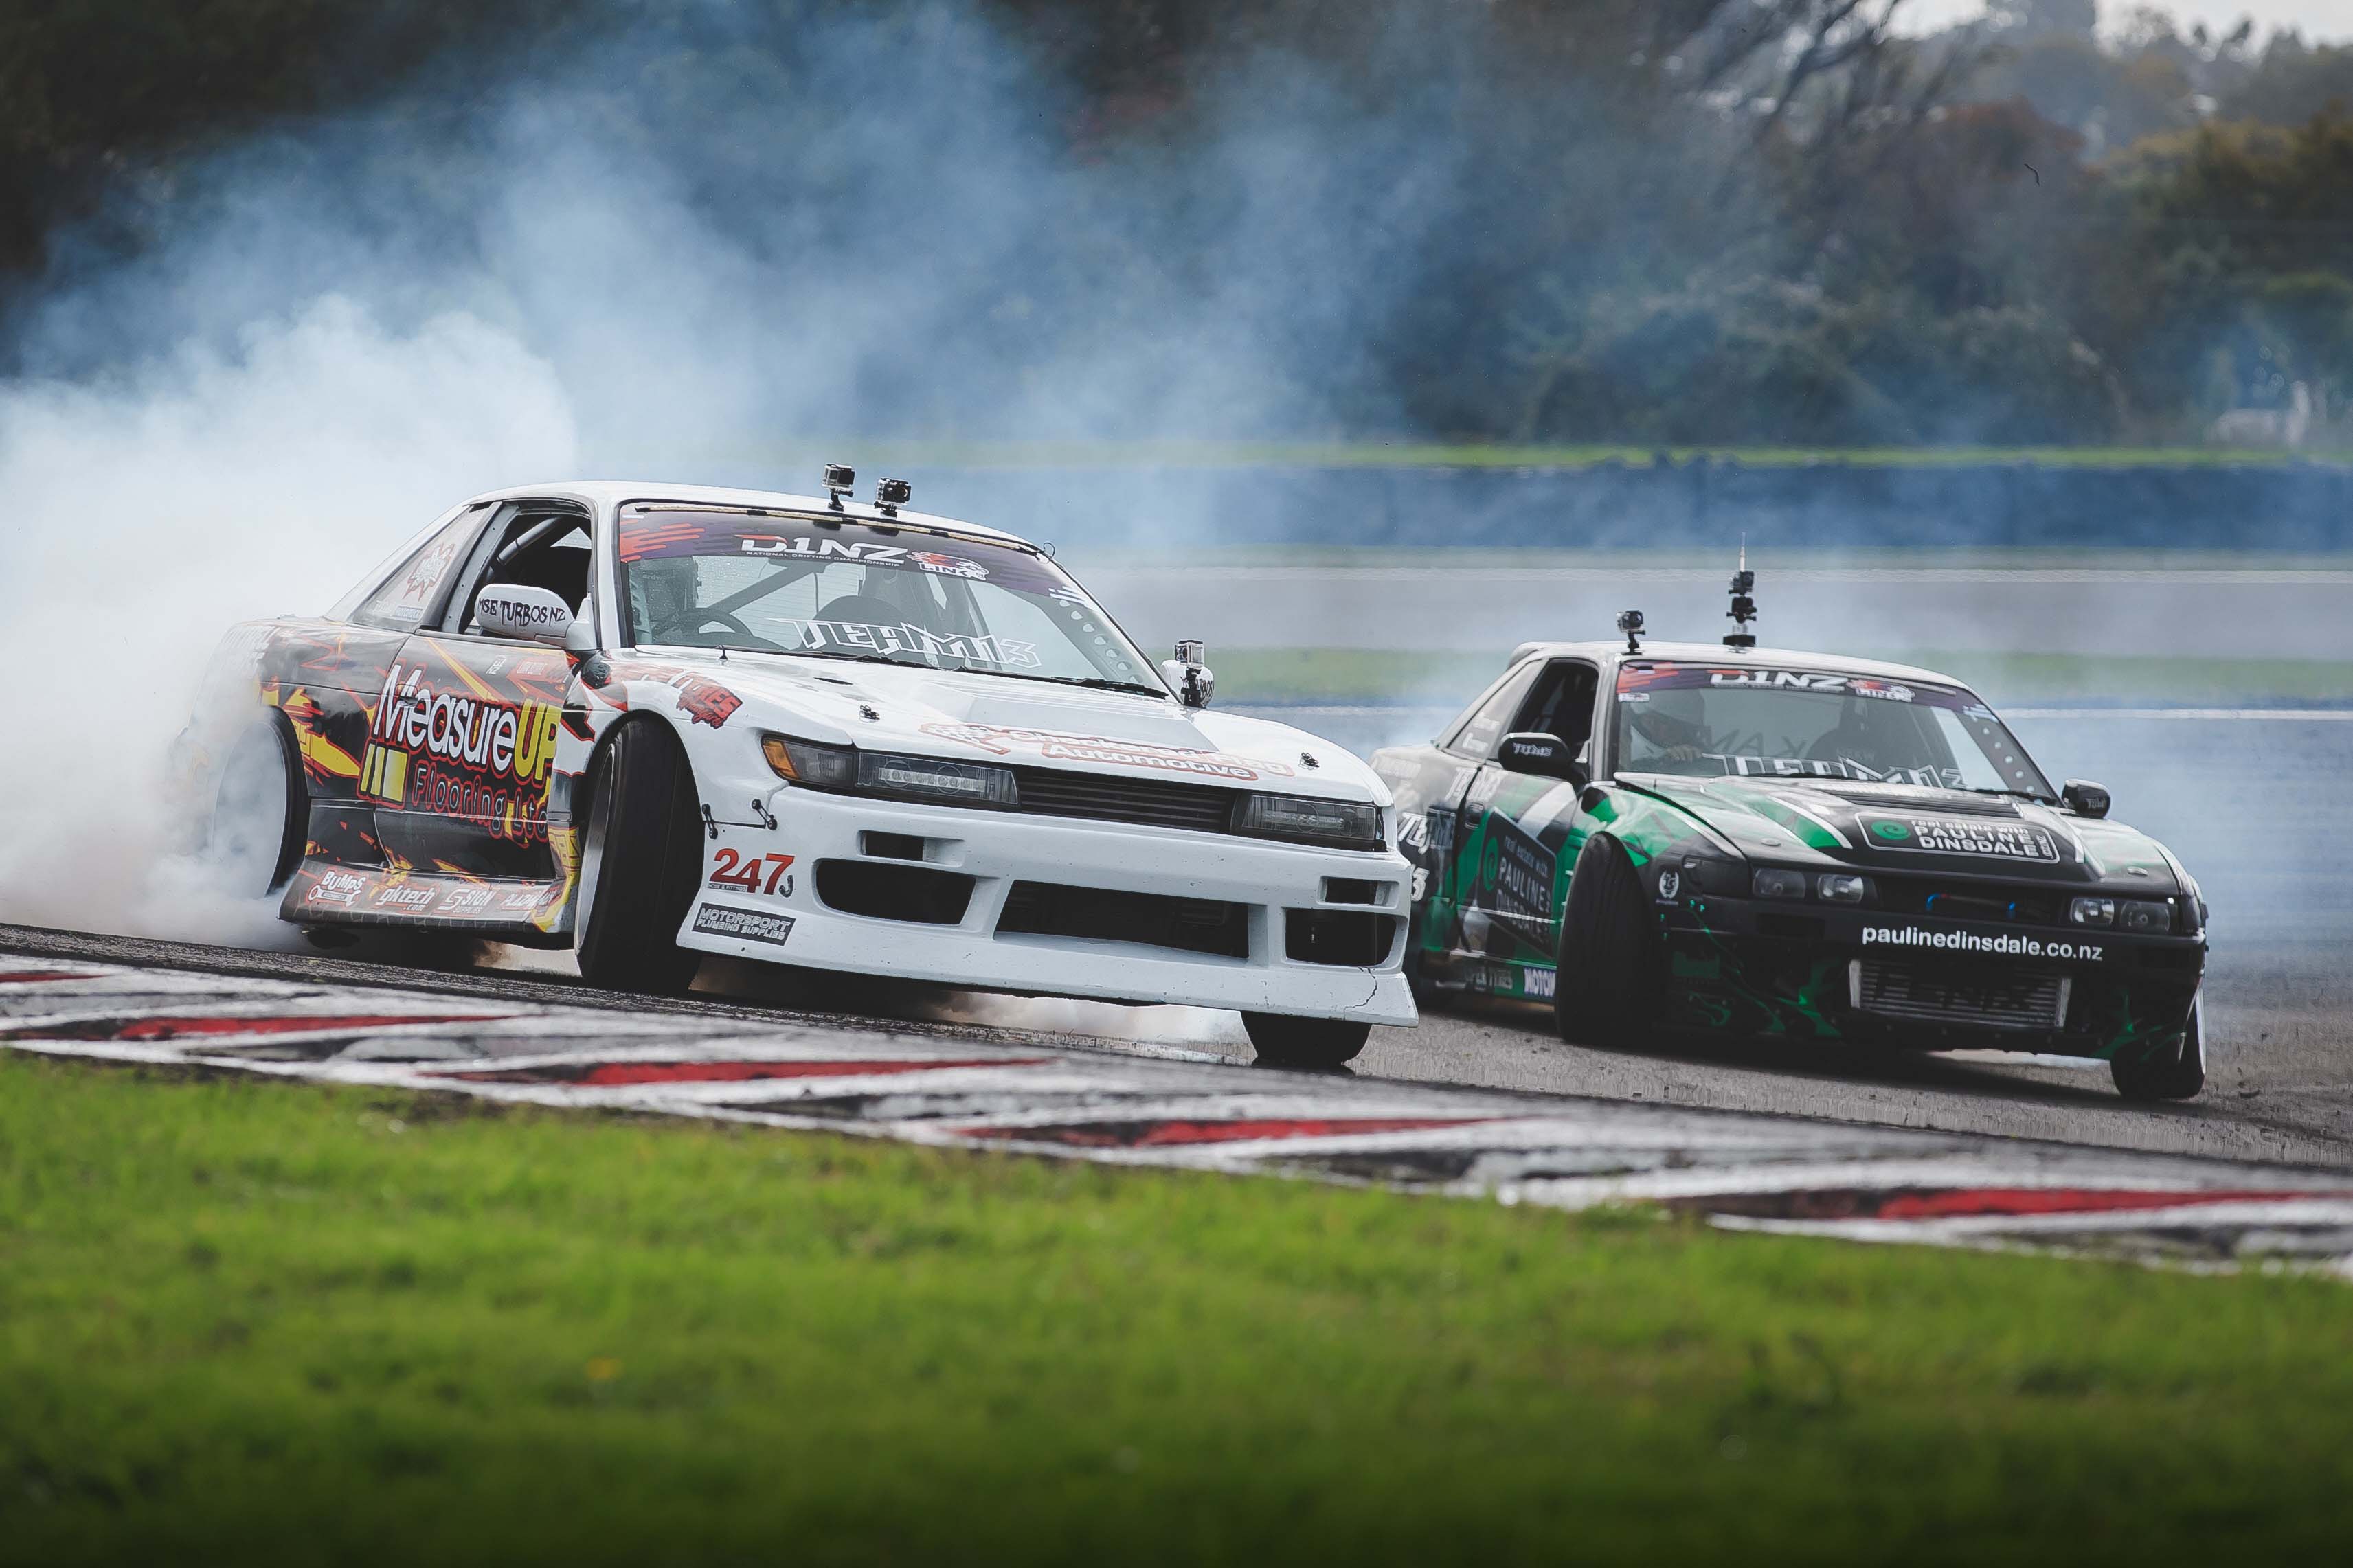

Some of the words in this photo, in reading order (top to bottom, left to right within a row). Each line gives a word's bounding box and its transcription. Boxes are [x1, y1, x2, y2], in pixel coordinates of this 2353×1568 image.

[735, 534, 908, 564] D1NZ
[834, 556, 901, 567] CHAMPIONSHIP
[500, 600, 548, 627] TURBOS
[549, 606, 565, 626] NZ
[1009, 730, 1200, 759] Checkered
[1210, 753, 1285, 773] Flag
[1049, 744, 1252, 778] Automotive
[414, 767, 505, 831] Flooring
[1914, 826, 2036, 845] PAULINE
[1919, 835, 2039, 857] DINSDALE
[709, 848, 796, 896] 247
[376, 885, 435, 906] gktech
[696, 918, 739, 932] PLUMBING
[741, 925, 787, 940] SUPPLIES
[699, 907, 791, 931] MOTORSPORT
[1862, 926, 2103, 961] paulinedinsdale.co.nz
